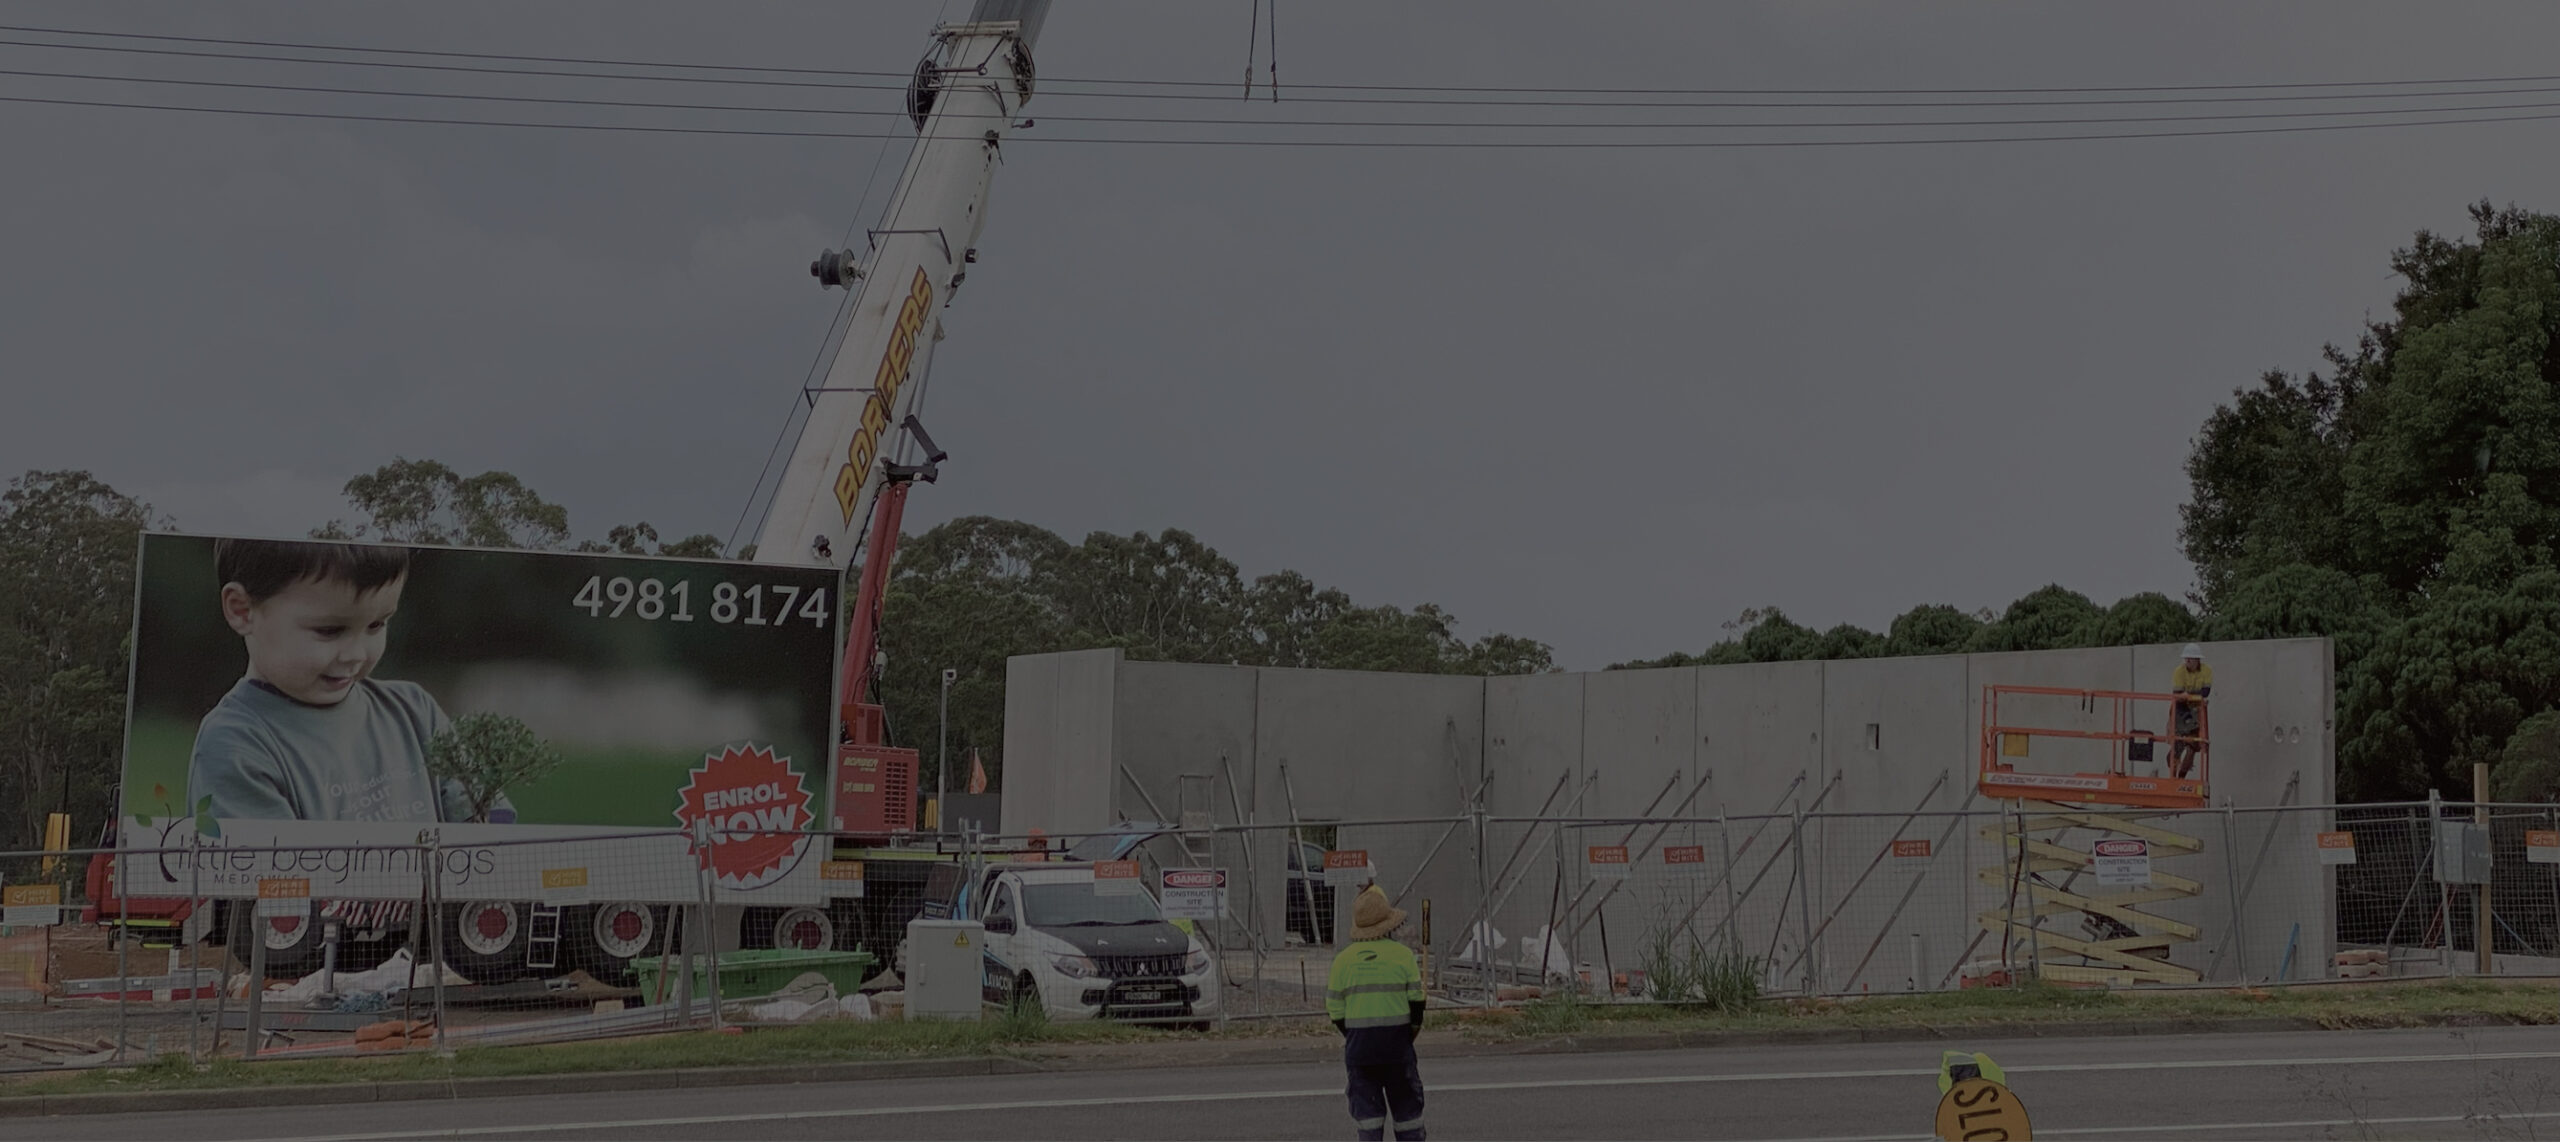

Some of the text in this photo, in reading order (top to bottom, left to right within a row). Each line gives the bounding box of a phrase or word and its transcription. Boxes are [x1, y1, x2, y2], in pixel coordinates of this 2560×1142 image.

[572, 575, 828, 628] 4981 8174
[703, 782, 788, 811] ENROL
[699, 804, 797, 845] NOW
[178, 834, 256, 871] little
[2103, 844, 2138, 853] DANGER
